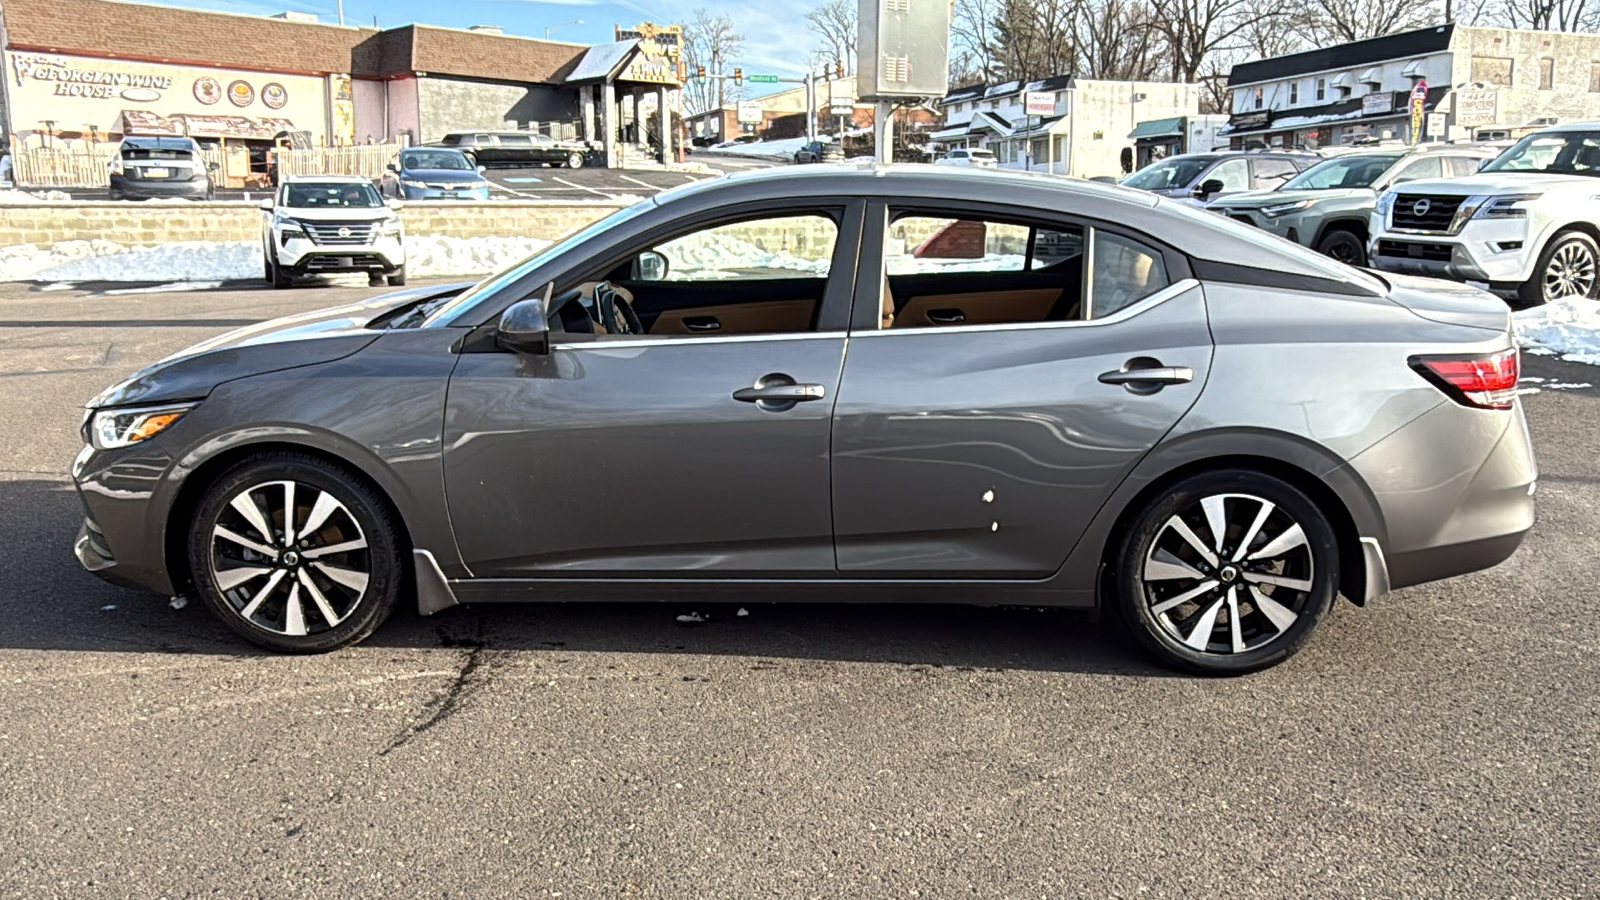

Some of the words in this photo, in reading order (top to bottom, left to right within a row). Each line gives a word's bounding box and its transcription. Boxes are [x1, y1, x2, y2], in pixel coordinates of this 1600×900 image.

[33, 67, 123, 86] GEORGIAN
[124, 73, 173, 89] WINE
[53, 83, 114, 99] HOUSE
